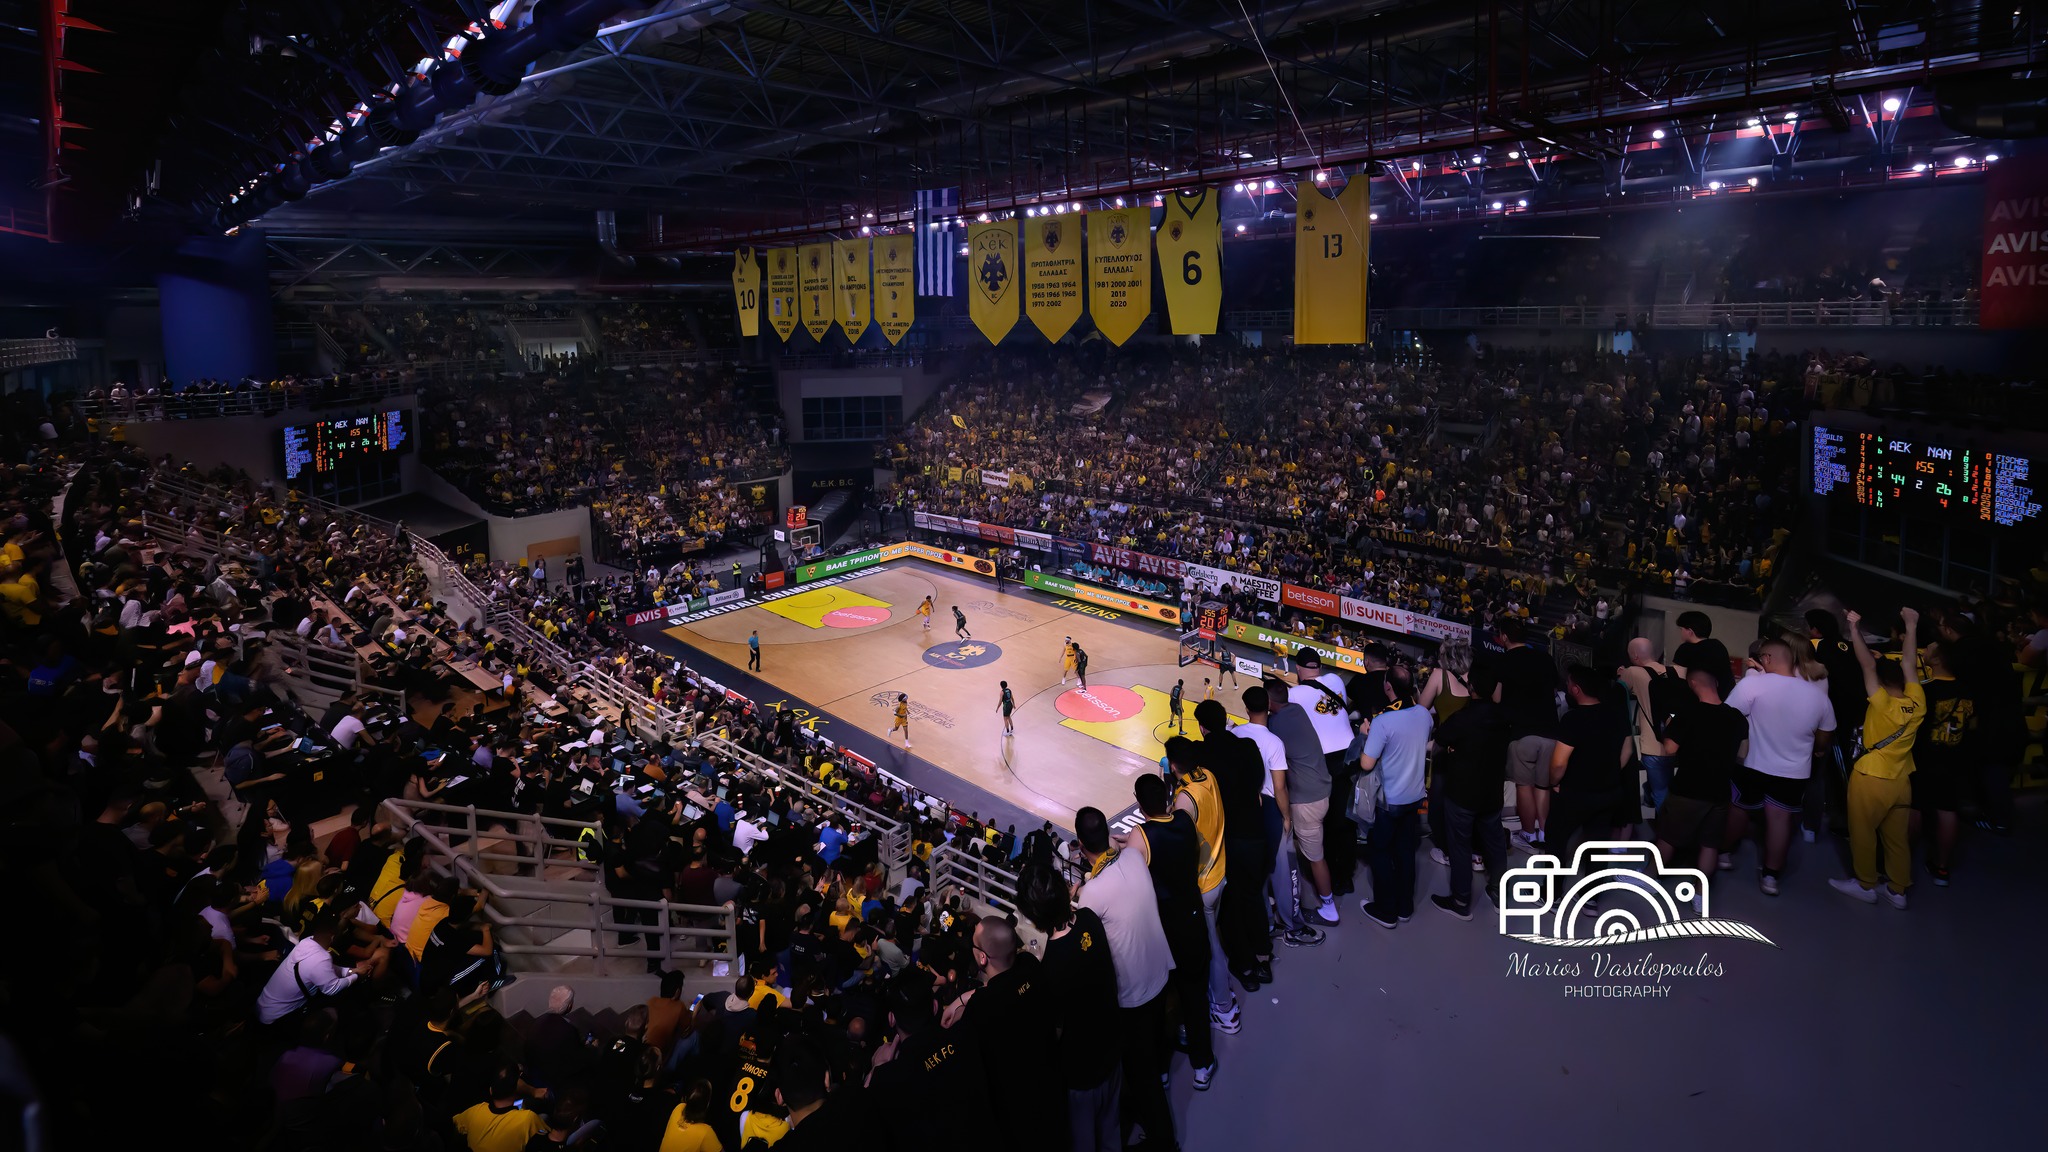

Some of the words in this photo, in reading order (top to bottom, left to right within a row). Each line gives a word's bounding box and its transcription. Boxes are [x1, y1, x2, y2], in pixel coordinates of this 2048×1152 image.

[1323, 234, 1342, 258] 13
[1183, 251, 1202, 285] 6
[740, 289, 755, 310] 10
[337, 442, 346, 450] 44
[1889, 440, 1912, 453] AEK
[1927, 446, 1952, 460] NAN
[1891, 473, 1905, 485] 44
[1915, 480, 1923, 489] 2
[1893, 487, 1901, 498] 3
[1939, 498, 1948, 508] 4
[795, 512, 806, 521] 20
[1092, 546, 1131, 568] AVIS
[1138, 552, 1180, 579] AVIS
[1188, 566, 1218, 581] Carlsberg
[1240, 577, 1279, 592] MAESTRO
[668, 598, 764, 626] BASKETBALL
[762, 578, 843, 602] CHAMPIONS
[1287, 588, 1334, 608] betsson
[634, 609, 661, 624] AVIS
[1050, 599, 1121, 619] ATHENS
[1356, 606, 1402, 626] SUNEL
[1200, 615, 1214, 628] 20
[1217, 614, 1227, 628] 20
[1414, 619, 1469, 635] METROPOLITAN
[1291, 869, 1299, 895] NIKE
[924, 1052, 942, 1072] AEK
[940, 1044, 955, 1059] FC
[741, 1062, 768, 1079] SIMOES
[730, 1076, 754, 1112] 8
